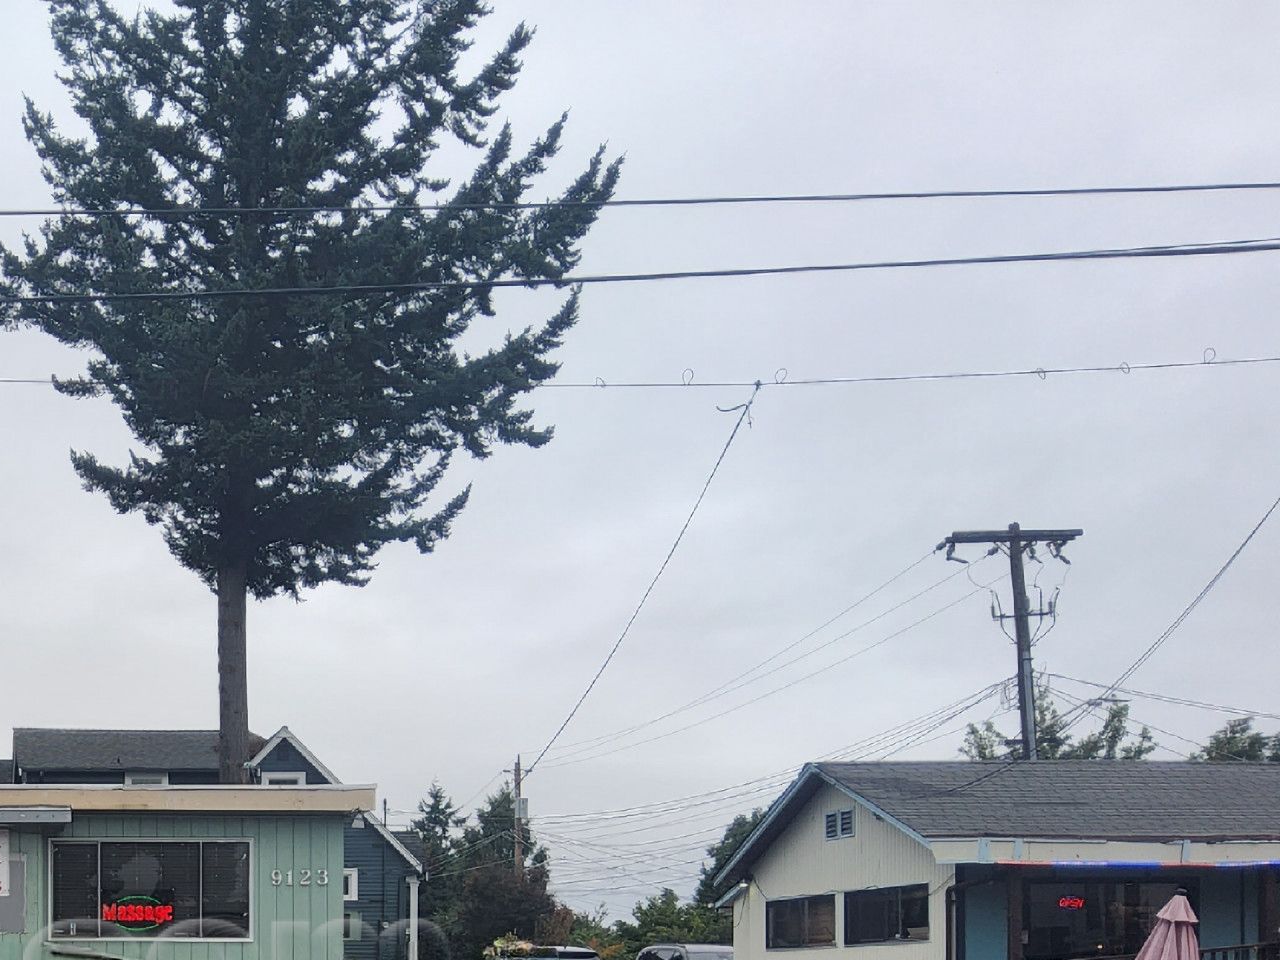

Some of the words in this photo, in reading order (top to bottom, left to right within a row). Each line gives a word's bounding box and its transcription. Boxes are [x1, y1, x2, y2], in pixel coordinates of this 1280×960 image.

[271, 868, 329, 887] 9123
[1059, 897, 1085, 909] OPEN
[102, 902, 173, 924] Massage
